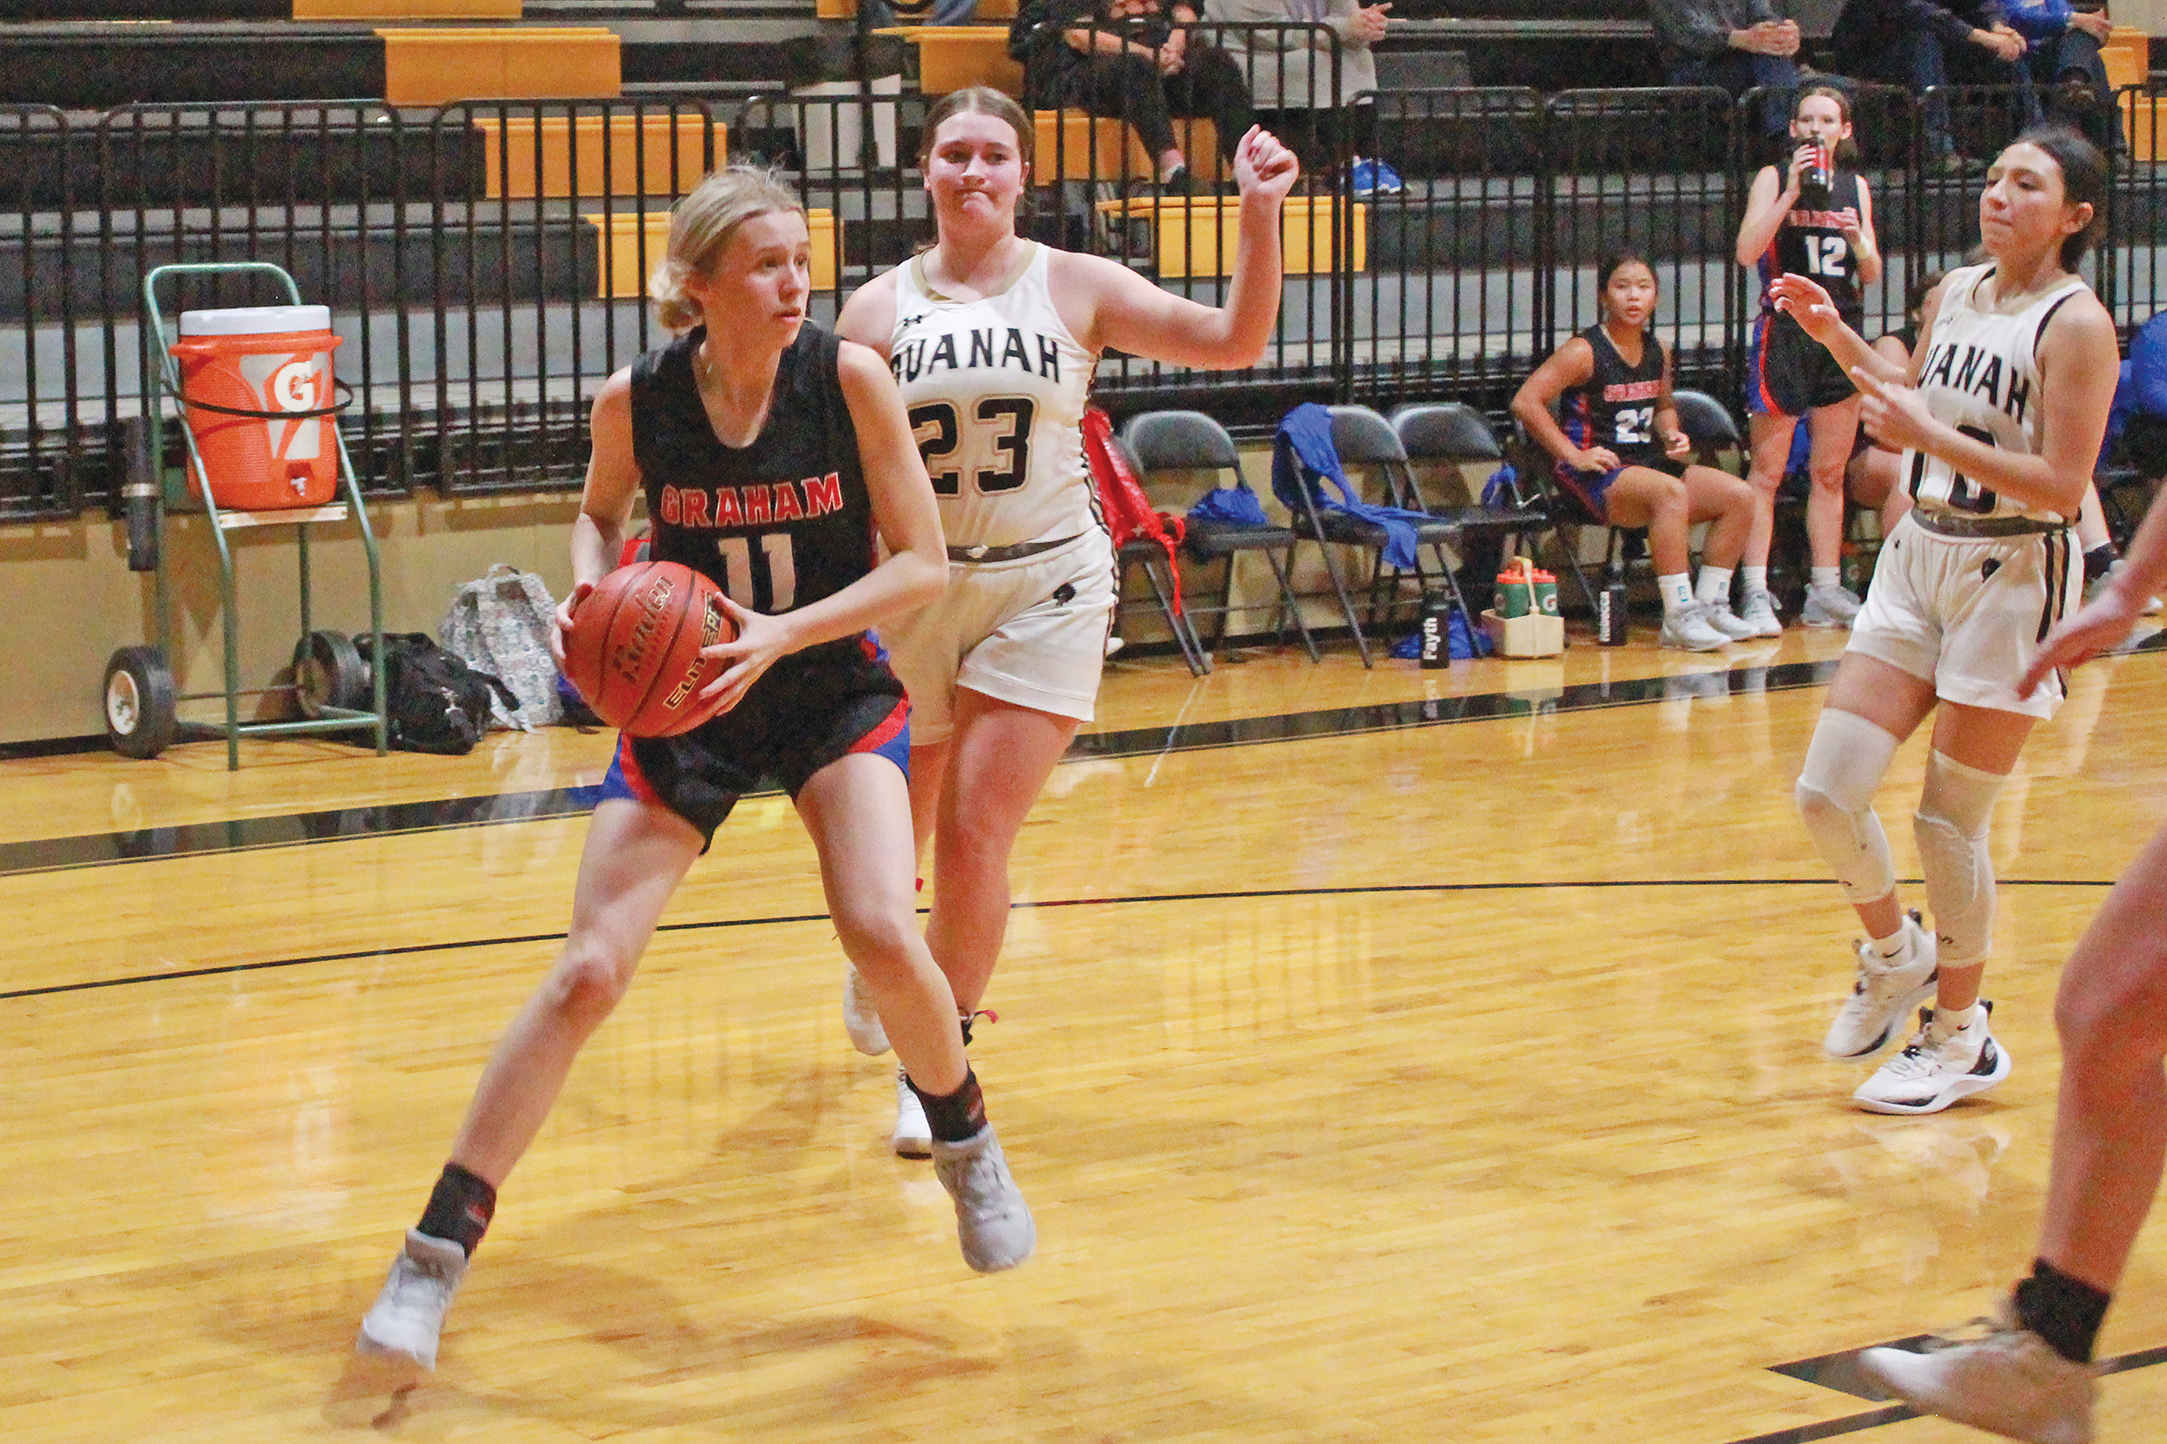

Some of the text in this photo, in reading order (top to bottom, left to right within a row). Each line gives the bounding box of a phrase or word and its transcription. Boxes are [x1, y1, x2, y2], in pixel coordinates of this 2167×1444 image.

[1805, 235, 1846, 276] 12
[274, 361, 315, 412] G
[1917, 343, 2030, 425] UANAH
[907, 394, 1039, 499] 23
[660, 472, 844, 528] GRAHAM
[718, 533, 796, 612] 11
[1423, 617, 1441, 660] Fayth
